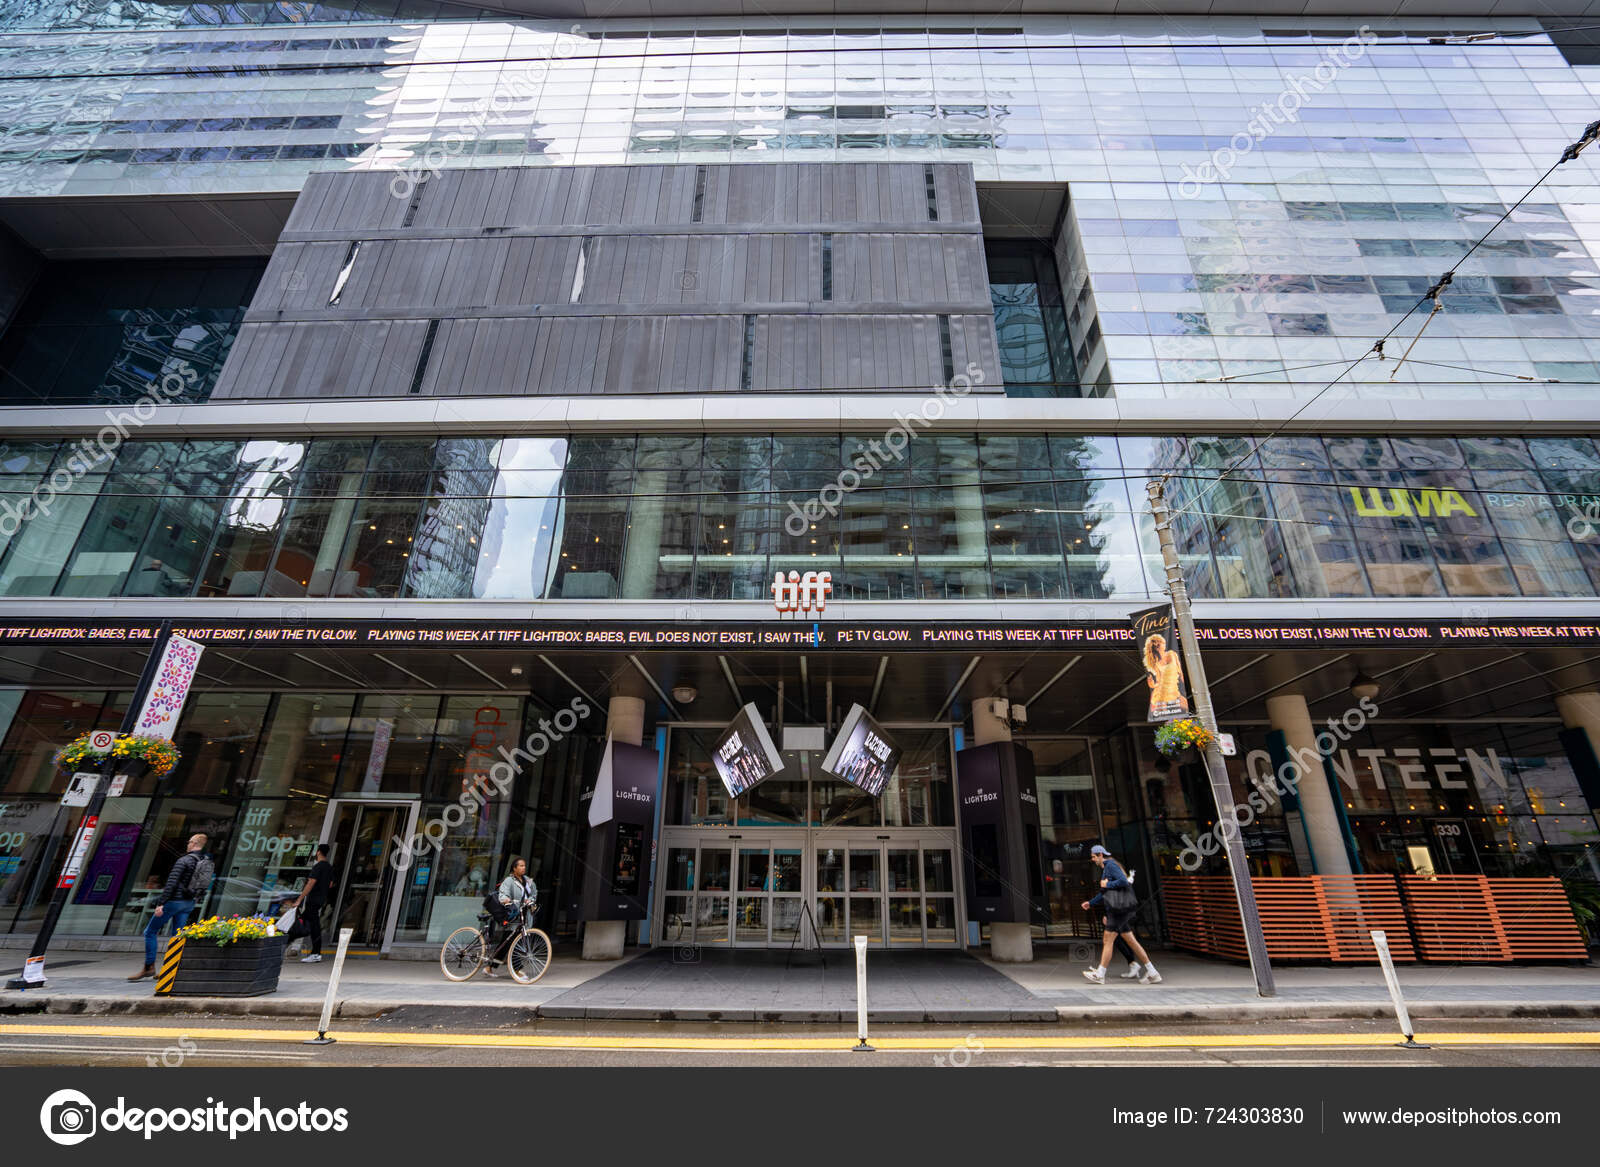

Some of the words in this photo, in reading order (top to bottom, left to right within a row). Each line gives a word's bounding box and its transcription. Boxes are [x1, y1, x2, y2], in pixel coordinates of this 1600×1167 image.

[771, 570, 832, 612] tiff
[1135, 611, 1171, 636] Tina
[6, 628, 31, 638] TIFF
[88, 628, 126, 640] BABES,
[128, 628, 152, 639] EVIL
[187, 628, 213, 639] NOT
[212, 629, 246, 640] EXIST,
[254, 630, 281, 640] SAW
[281, 630, 304, 640] THE
[306, 630, 321, 640] TV
[321, 630, 357, 640] GLOW.
[367, 630, 416, 641] PLAYING
[418, 630, 444, 641] THIS
[445, 631, 480, 641] WEEK
[480, 631, 497, 641] AT
[497, 631, 522, 641] TIFF
[523, 631, 584, 642] LIGHTBOX:
[585, 631, 626, 643] BABES,
[628, 631, 654, 642] EVIL
[656, 632, 691, 643] DOES
[692, 632, 718, 643] NOT
[719, 632, 756, 644] EXIST,
[764, 632, 791, 643] SAW
[855, 630, 872, 641] TV
[872, 630, 912, 641] GLOW.
[922, 630, 974, 641] PLAYING
[975, 630, 1004, 641] THIS
[1004, 630, 1042, 641] WEEK
[1042, 630, 1058, 641] AT
[1058, 629, 1084, 640] TIFF
[1194, 628, 1219, 639] EVIL
[1219, 628, 1253, 639] DOES
[1254, 628, 1279, 639] NOT
[1280, 628, 1317, 640] EXIST,
[1323, 628, 1349, 639] SAW
[1350, 627, 1376, 638] THE
[1375, 627, 1391, 638] TV
[1392, 627, 1432, 638] GLOW.
[1440, 627, 1490, 638] PLAYING
[1490, 627, 1518, 637] THIS
[1517, 627, 1555, 637] WEEK
[1555, 626, 1570, 637] AT
[1570, 626, 1595, 637] TIFF
[616, 790, 651, 802] LIGHTBOX
[964, 792, 998, 804] LIGHTBOX
[246, 807, 272, 826] tiff
[1437, 824, 1461, 836] 330
[238, 830, 294, 857] Shop
